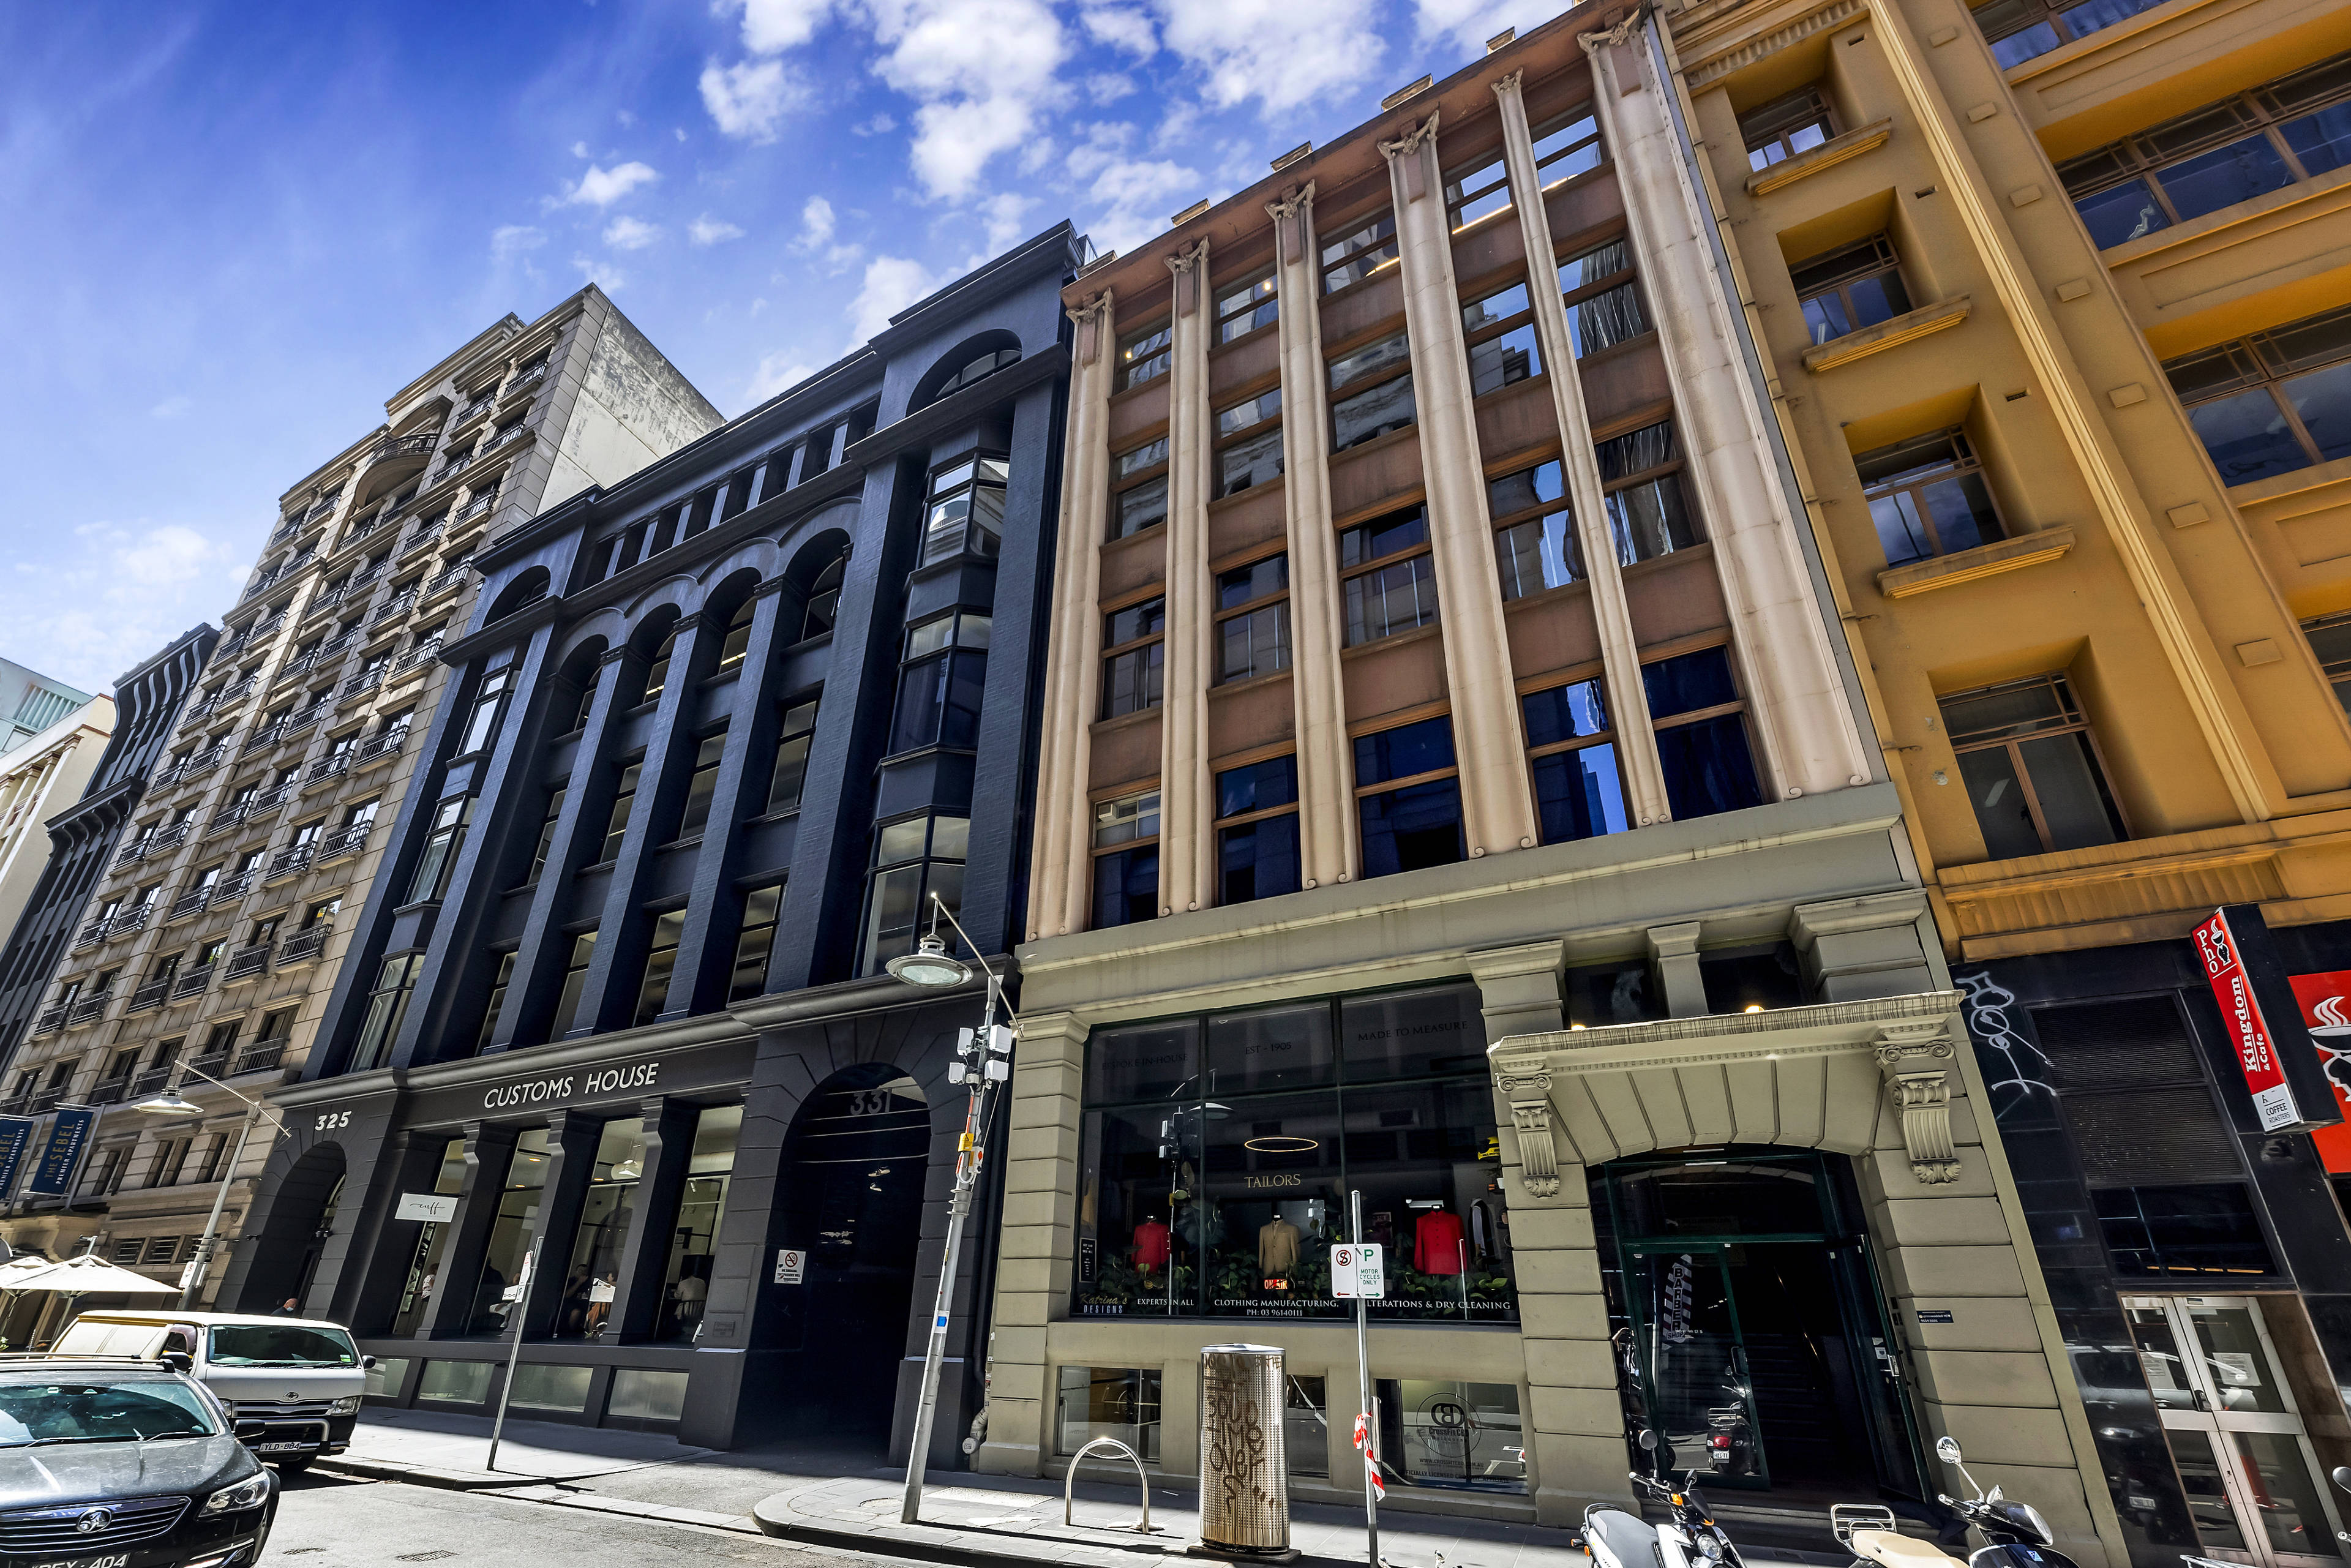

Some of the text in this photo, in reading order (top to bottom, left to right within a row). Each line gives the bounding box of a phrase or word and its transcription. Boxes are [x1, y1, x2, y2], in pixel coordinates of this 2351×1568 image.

[2197, 929, 2219, 973] Pho
[1358, 1021, 1468, 1041] MADE TO MEASURE
[2231, 975, 2258, 1072] Kingdom
[1245, 1045, 1261, 1056] EST
[1270, 1041, 1292, 1051] 1905
[484, 1062, 659, 1109] CUSTOMS HOUSE
[850, 1087, 892, 1116] 331
[2265, 1102, 2288, 1116] COFFEE
[315, 1111, 352, 1131] 325
[2268, 1111, 2291, 1124] ROASTERS
[7, 1128, 25, 1163] APARTMENTS
[45, 1123, 75, 1178] THE SEBEL
[55, 1119, 84, 1185] PREMIER APARTMENTS
[1243, 1174, 1302, 1188] TAILORS
[1364, 1249, 1374, 1261] P
[1264, 1279, 1273, 1289] ON
[1079, 1292, 1128, 1305] Katrina's
[1365, 1300, 1423, 1308] LTERATIONS
[1458, 1301, 1511, 1310] CLEANING
[1672, 1267, 1684, 1332] BARBER
[1084, 1305, 1122, 1314] DESIGNS
